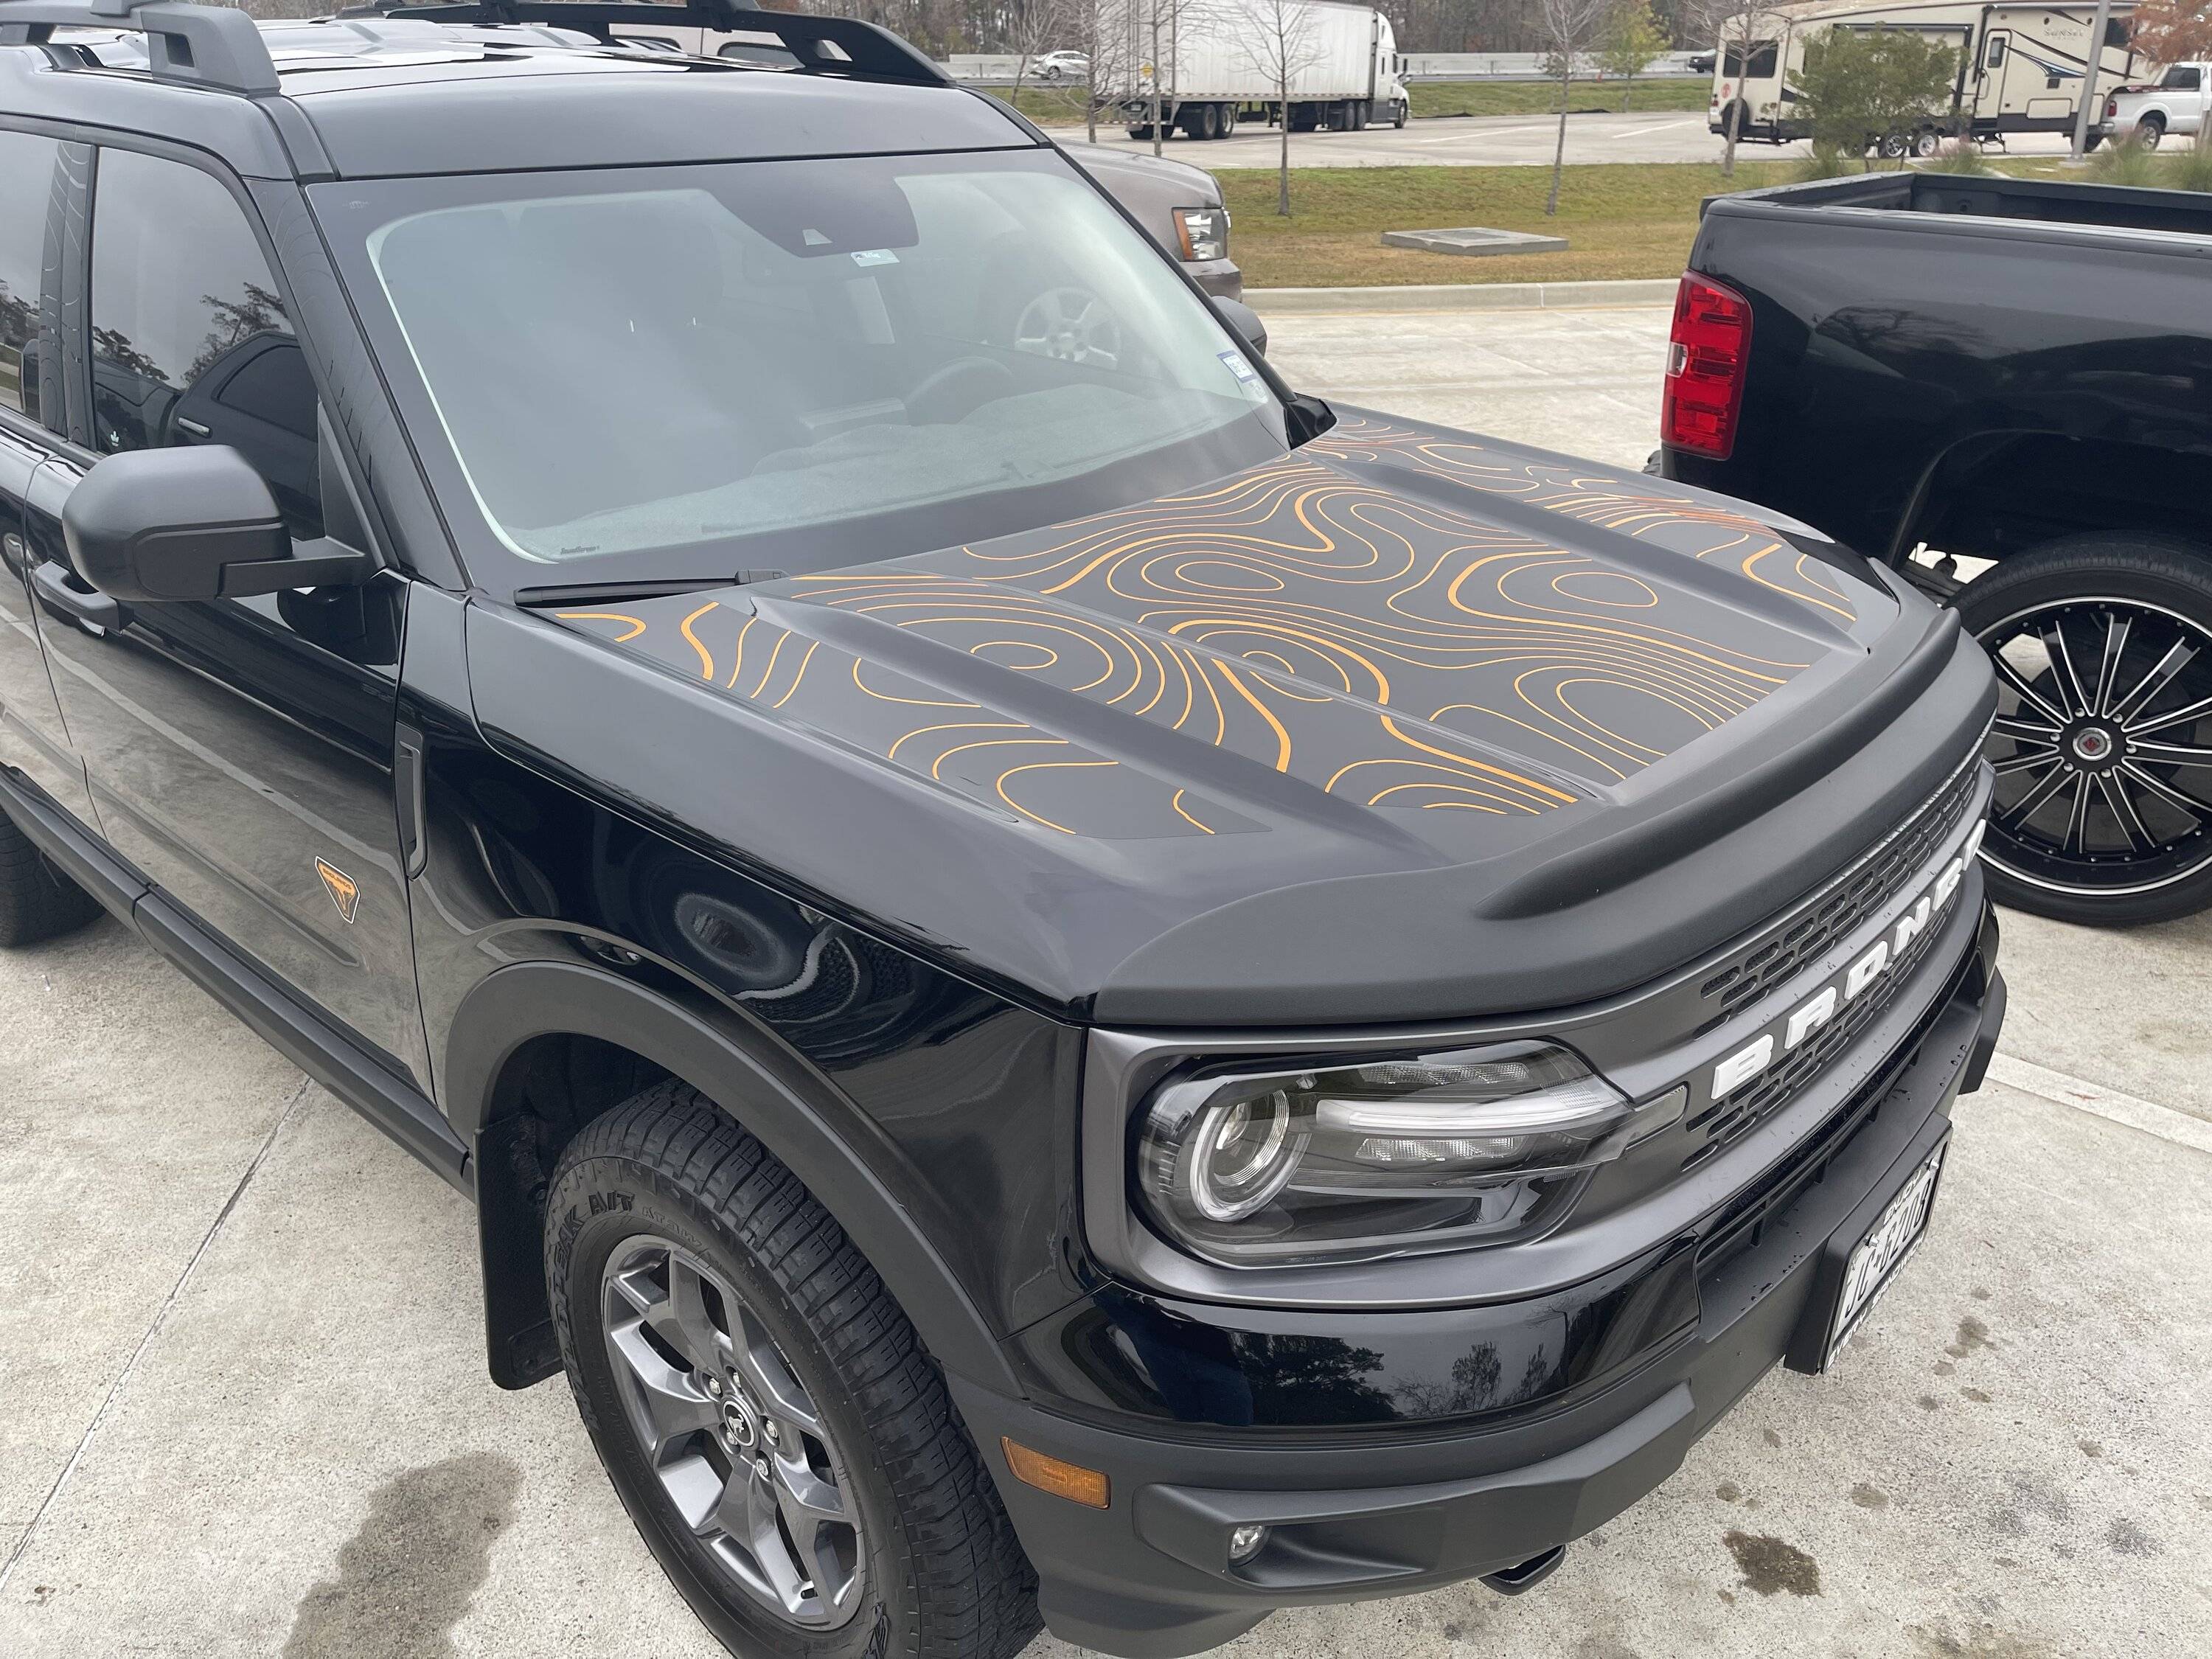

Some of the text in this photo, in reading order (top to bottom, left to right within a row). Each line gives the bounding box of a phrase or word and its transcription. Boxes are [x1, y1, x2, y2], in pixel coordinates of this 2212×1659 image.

[1710, 818, 1987, 1101] BRONCO
[1883, 1169, 1922, 1225] ENJOY
[1827, 1228, 1926, 1369] EVERY SANDWICH
